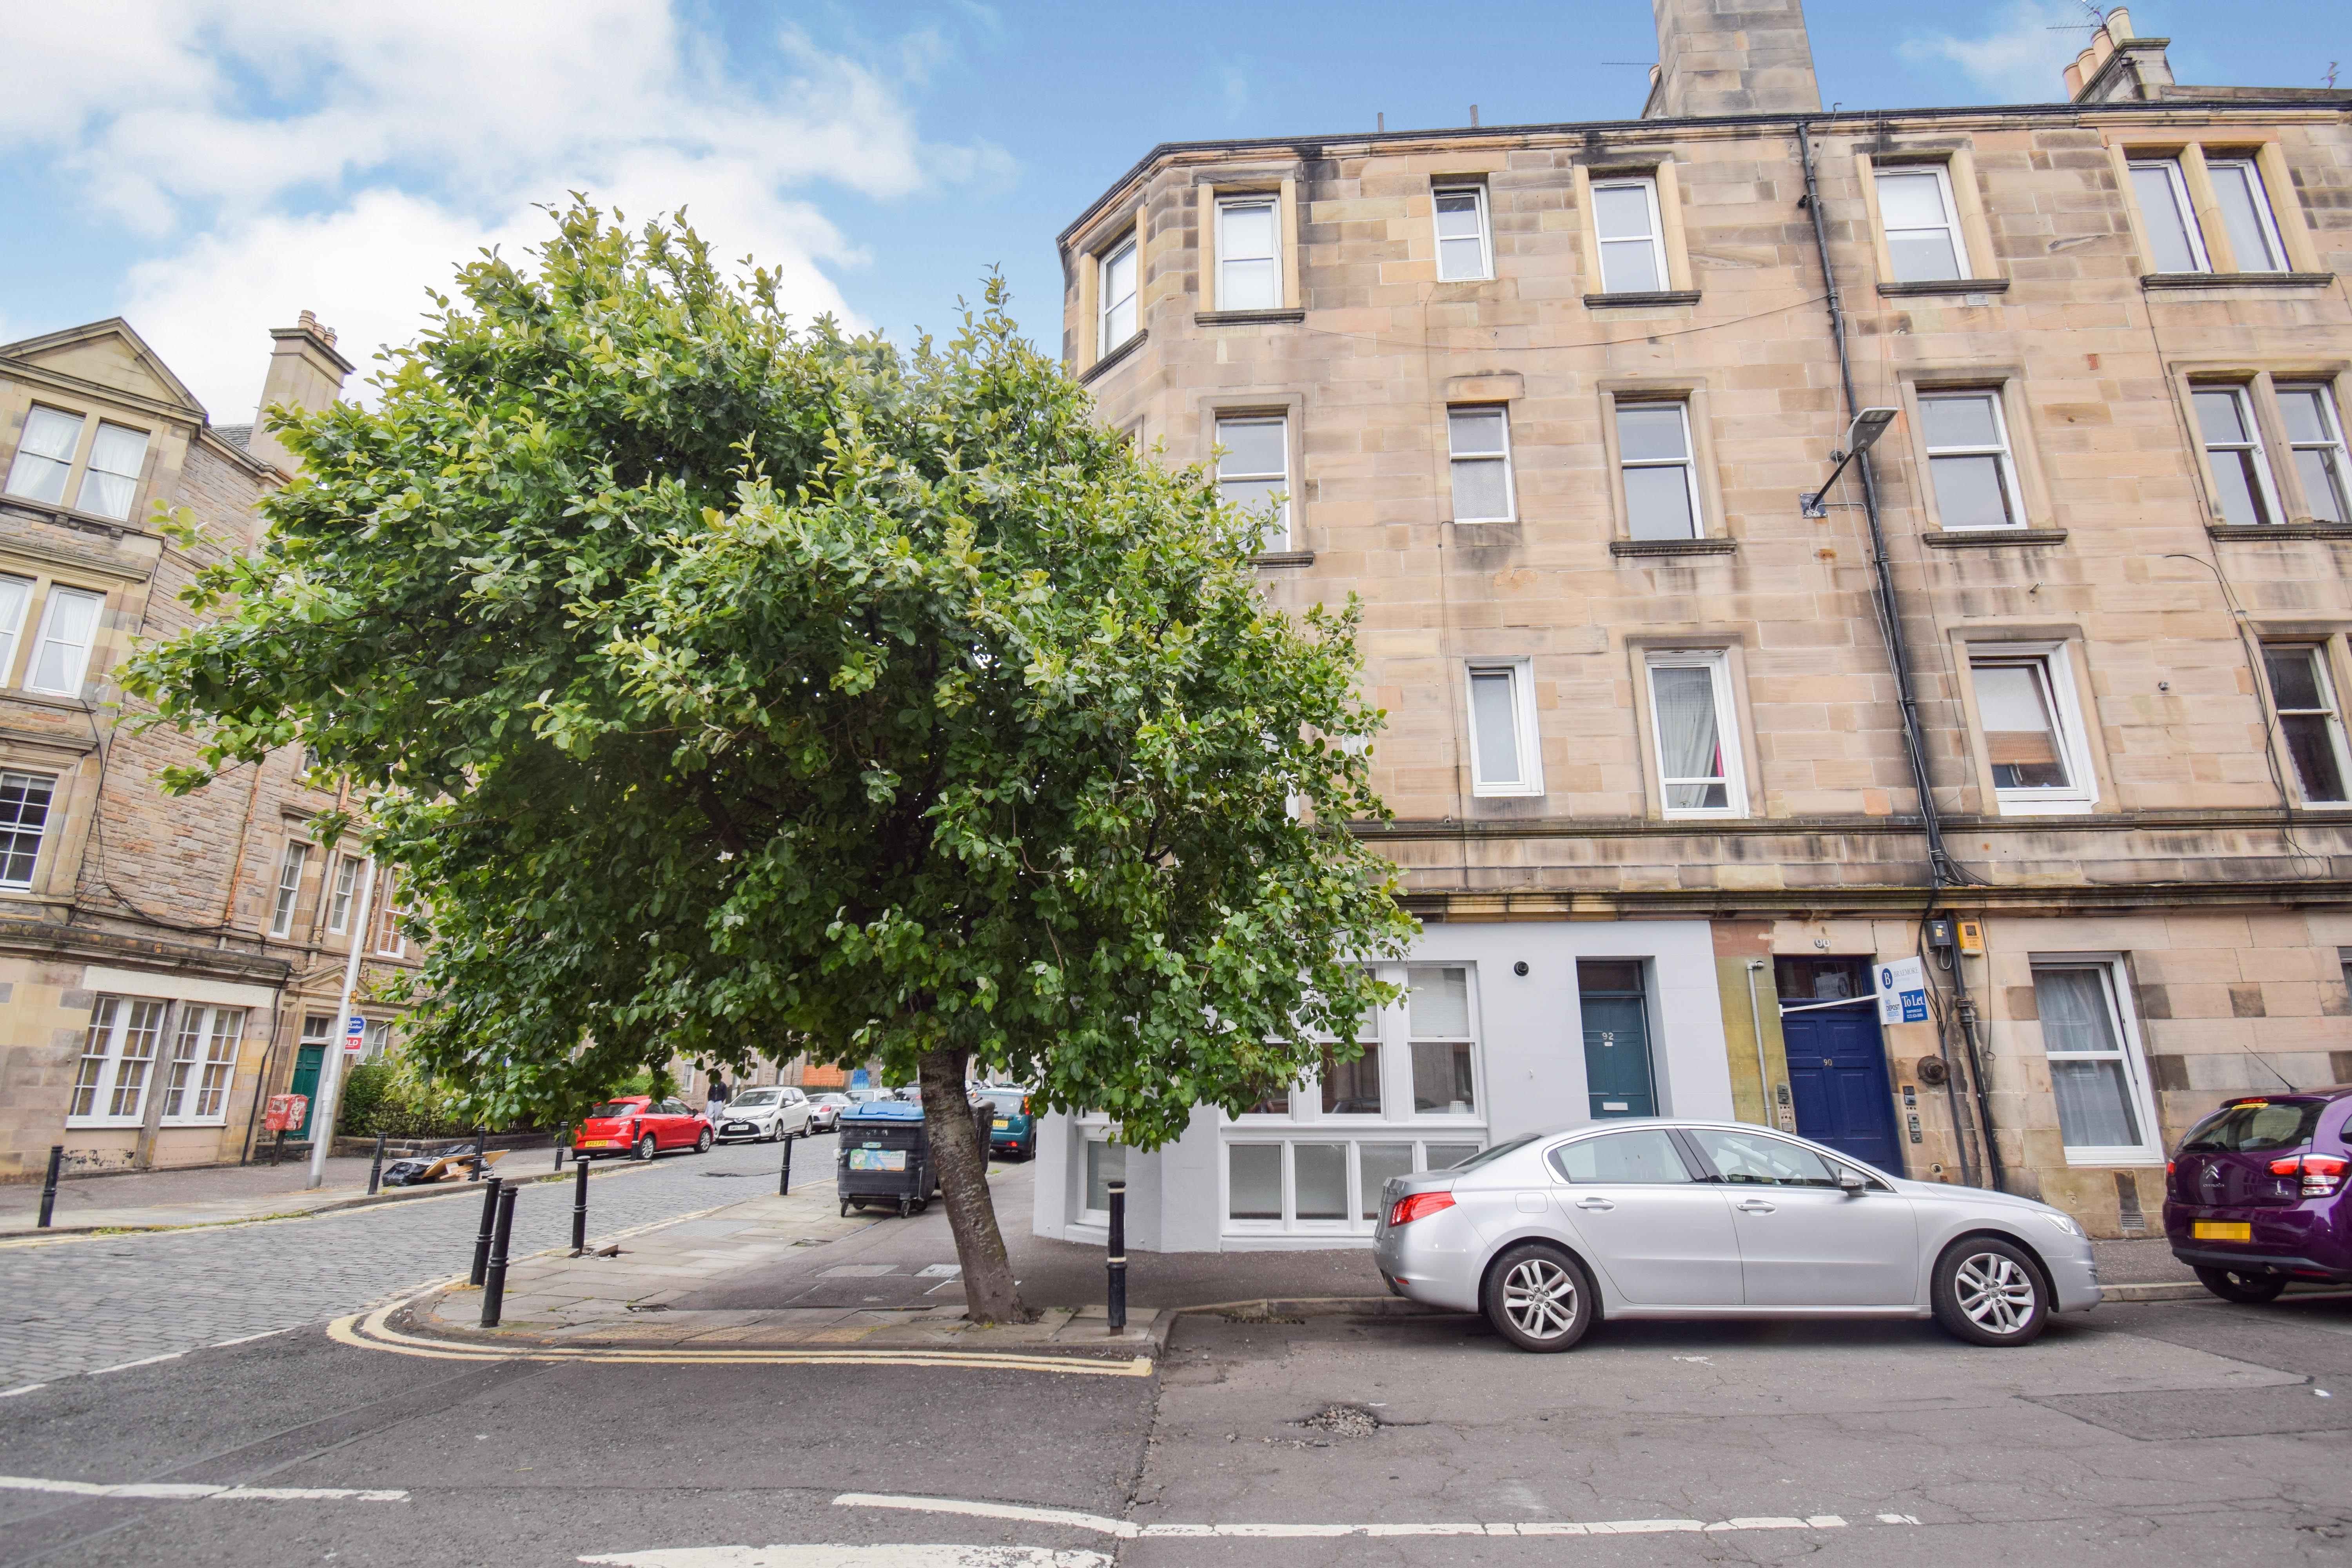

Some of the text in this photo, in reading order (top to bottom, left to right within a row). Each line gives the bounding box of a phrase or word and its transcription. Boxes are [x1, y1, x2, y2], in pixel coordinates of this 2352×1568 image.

[1815, 938, 1830, 947] 90
[1893, 967, 1919, 978] BRAEMORE
[1884, 972, 1891, 985] B
[1901, 996, 1911, 1007] To
